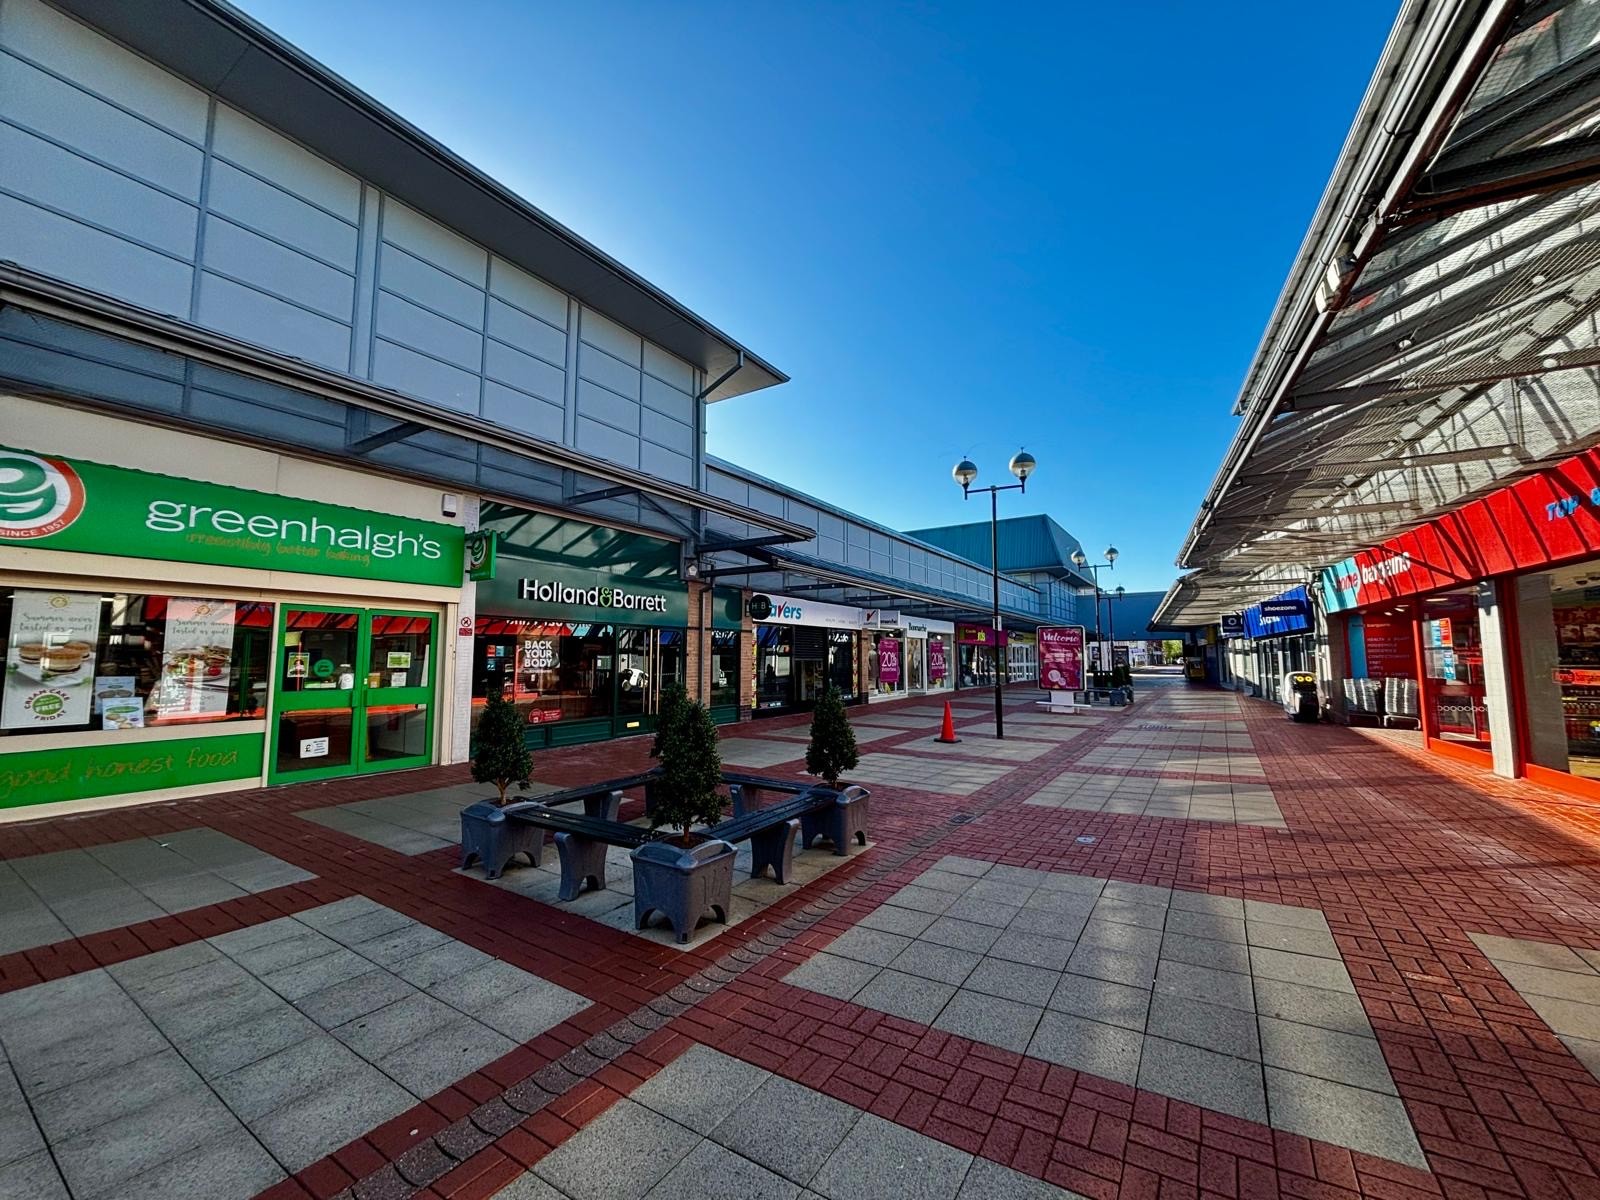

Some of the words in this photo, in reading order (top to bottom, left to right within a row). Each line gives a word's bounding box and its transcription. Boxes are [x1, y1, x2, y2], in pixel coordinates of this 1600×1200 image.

[41, 519, 66, 534] 1957
[145, 500, 441, 559] greenhalgh's
[1361, 555, 1412, 585] bargains
[524, 640, 553, 650] BACK
[524, 649, 553, 659] YOUR
[524, 658, 553, 668] BODY
[35, 702, 61, 712] FREE
[86, 754, 174, 778] honest
[187, 745, 238, 768] food
